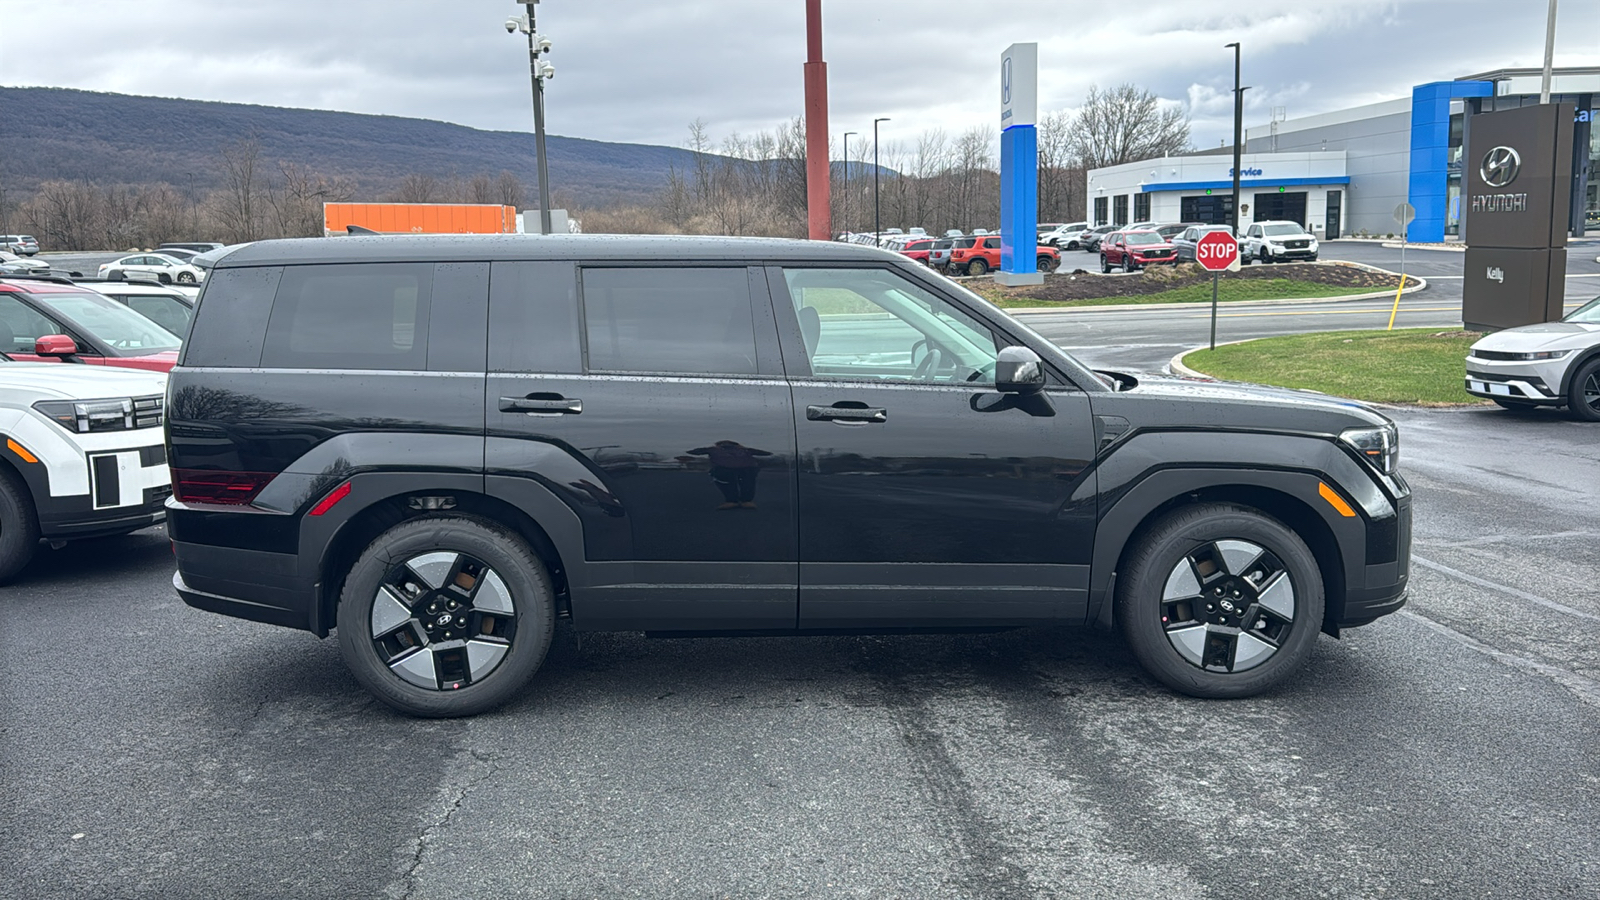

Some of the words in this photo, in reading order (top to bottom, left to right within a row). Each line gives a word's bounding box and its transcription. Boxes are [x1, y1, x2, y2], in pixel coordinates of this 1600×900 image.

[1229, 167, 1263, 177] Srvice
[1472, 193, 1528, 212] HYUNDAI
[1199, 243, 1236, 259] STOP
[1486, 266, 1504, 284] Kelly
